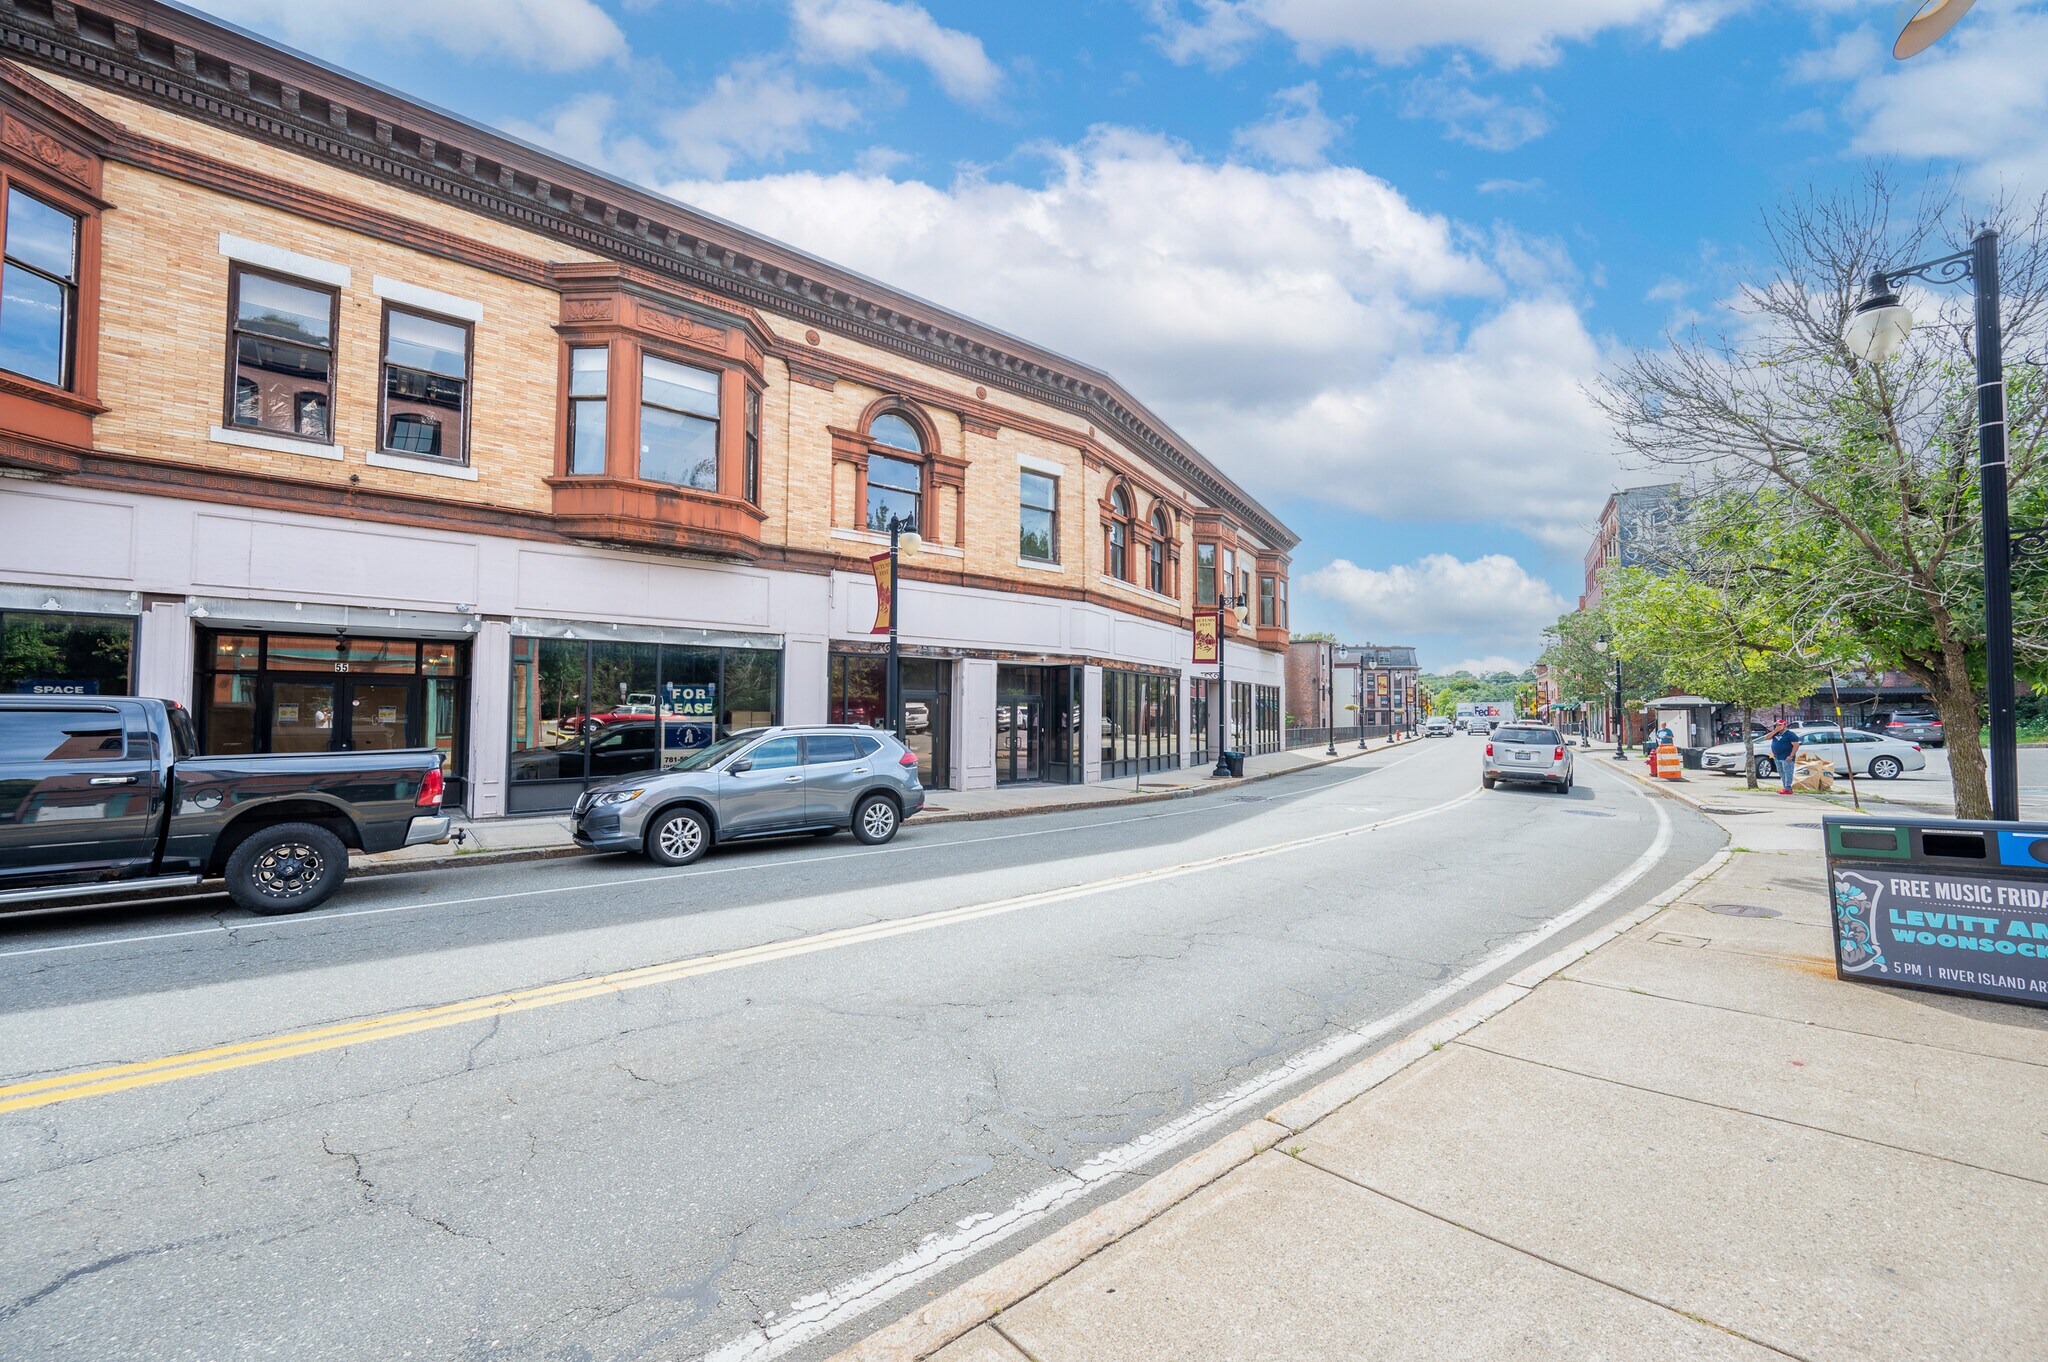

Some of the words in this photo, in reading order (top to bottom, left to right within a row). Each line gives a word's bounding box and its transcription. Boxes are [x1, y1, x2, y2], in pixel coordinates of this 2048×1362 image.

[335, 663, 348, 672] 55
[33, 685, 84, 694] SPACE
[672, 688, 706, 699] FOR
[1474, 706, 1500, 717] FedEx
[1890, 878, 1931, 899] FREE
[1934, 881, 1993, 904] MUSIC
[1889, 908, 2000, 934] LEVITT
[1891, 928, 2048, 959] WOONSOCK
[1893, 961, 1901, 974] 5
[1904, 962, 1922, 976] PM
[1938, 967, 1975, 983] RIVER
[1978, 972, 2026, 990] ISLAND
